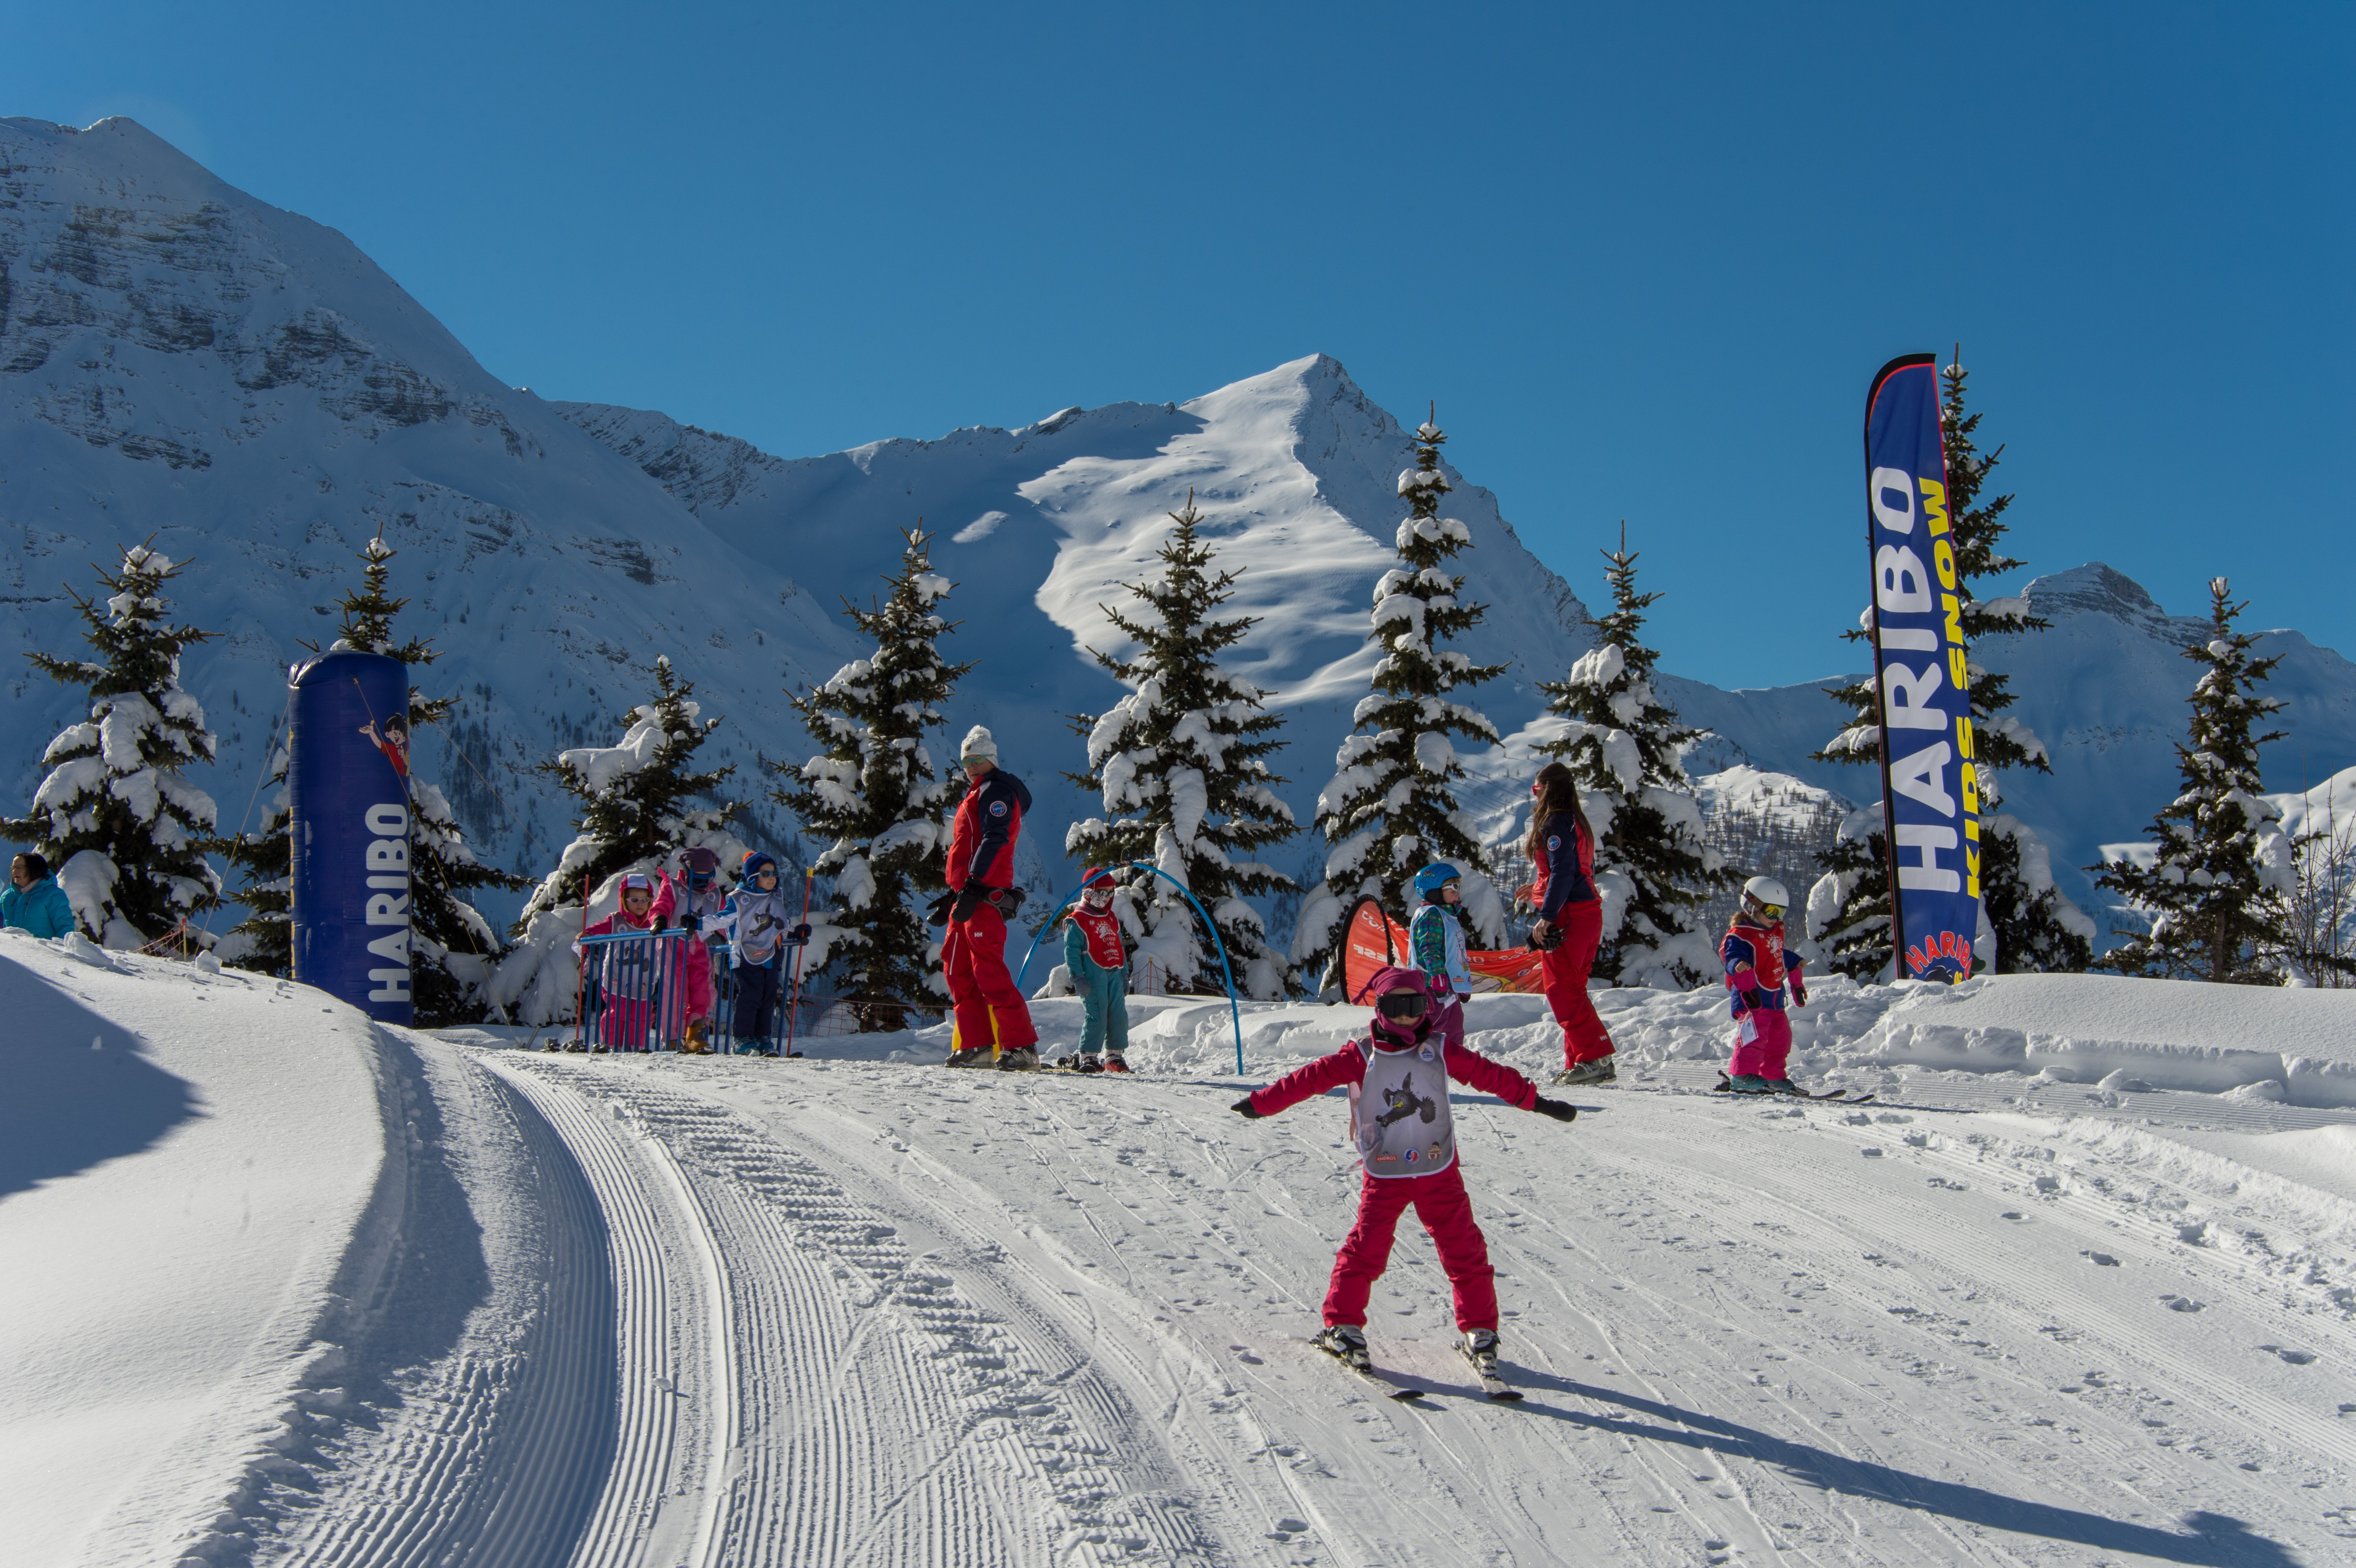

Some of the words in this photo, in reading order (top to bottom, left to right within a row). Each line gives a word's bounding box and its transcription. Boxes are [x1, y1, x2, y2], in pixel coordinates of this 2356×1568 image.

[1871, 466, 1961, 893] HARIBO
[1919, 477, 1968, 690] SNOW
[364, 803, 411, 1002] HARIBO
[1956, 716, 1980, 899] KIDS
